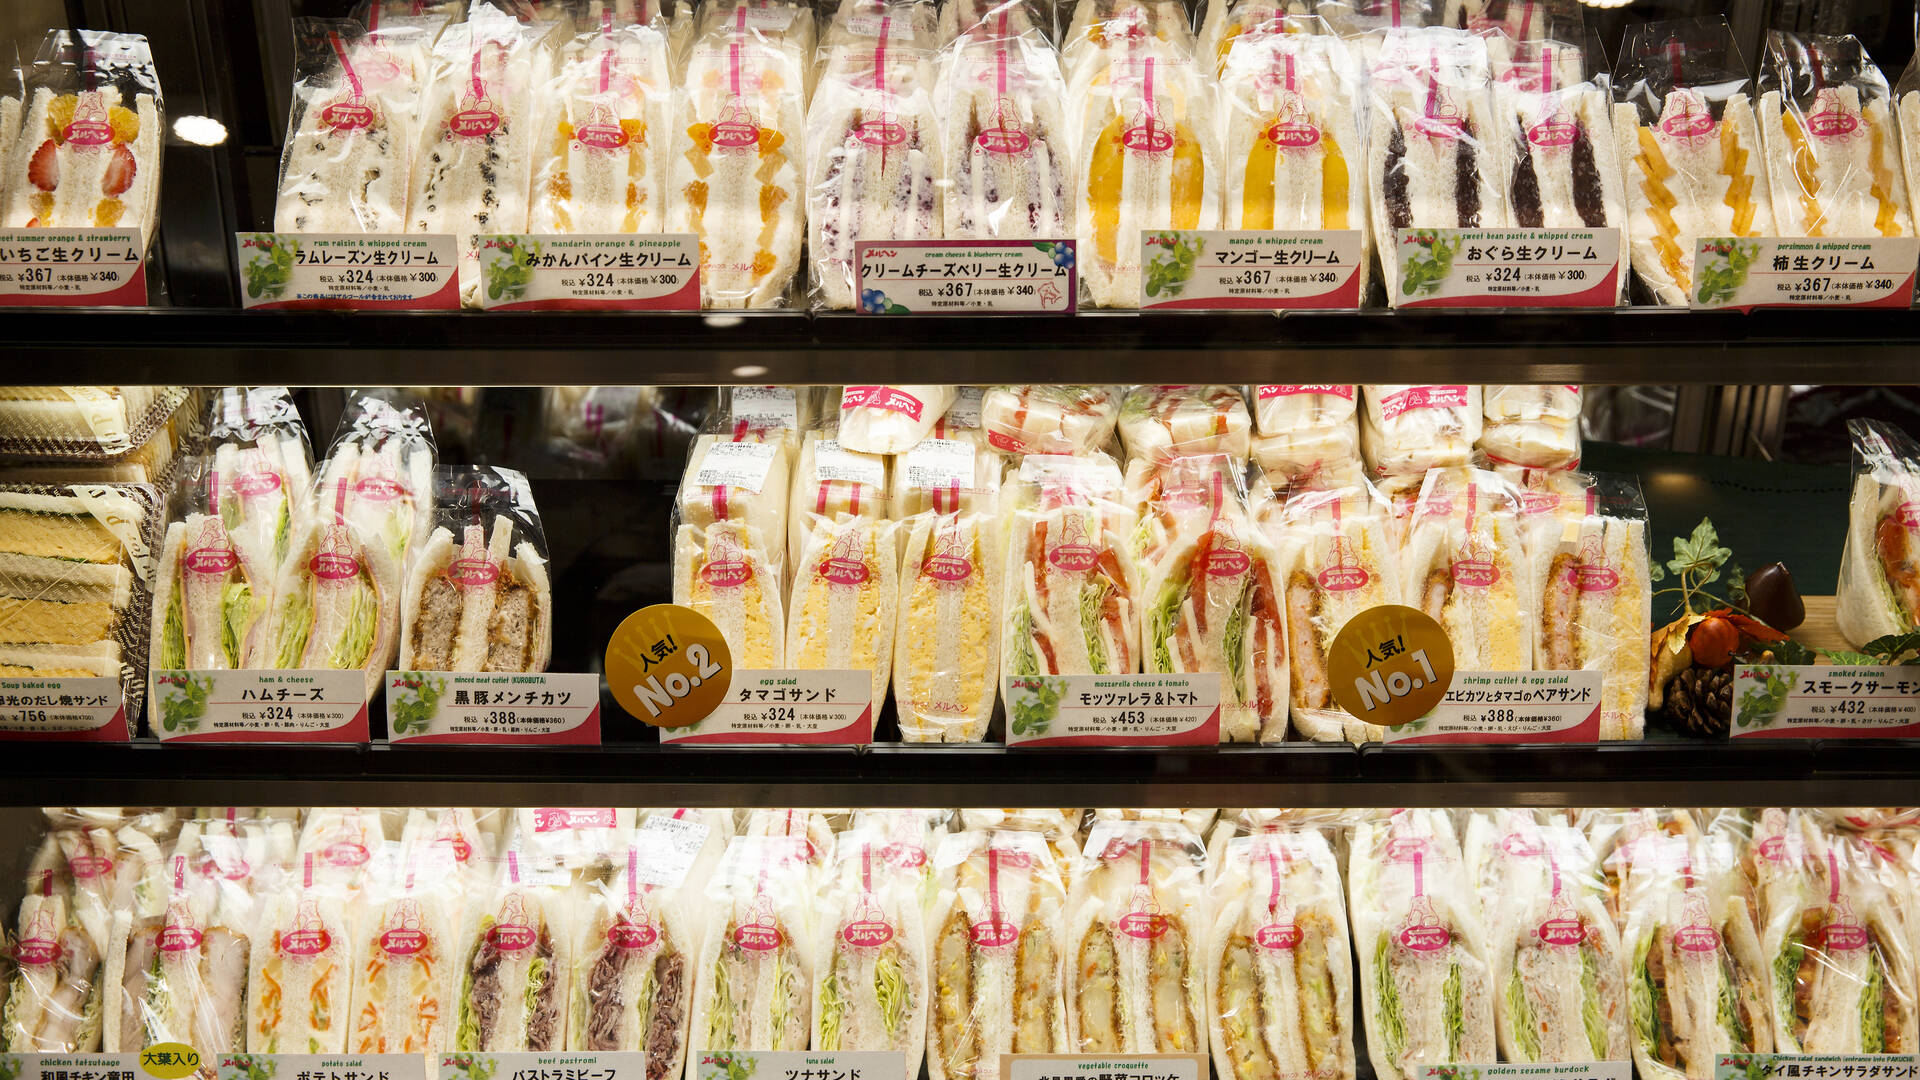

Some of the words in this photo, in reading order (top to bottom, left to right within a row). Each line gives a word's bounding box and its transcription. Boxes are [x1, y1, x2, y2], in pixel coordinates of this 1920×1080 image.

[86, 235, 131, 243] strawberry
[332, 239, 355, 247] raisin
[359, 239, 365, 247] &
[368, 239, 399, 248] whipped
[1266, 237, 1297, 246] whipped
[1462, 232, 1484, 240] sweet
[1486, 232, 1504, 240] bean
[1507, 232, 1527, 241] paste
[1530, 232, 1536, 240] &
[1539, 232, 1567, 241] whipped
[551, 239, 592, 248] mandarin
[595, 240, 625, 249] orange
[629, 239, 636, 247] &
[639, 239, 681, 249] pineapple
[1777, 243, 1814, 251] persimmon
[1823, 243, 1849, 251] whipped
[296, 249, 439, 265] ラムレーズン生クリーム
[864, 249, 897, 259] メルヘン
[946, 250, 966, 258] cheese
[974, 250, 1002, 259] blueberry
[1215, 250, 1341, 266] マンゴー生クリーム
[1467, 246, 1598, 262] おぐら生クリーム
[860, 263, 1067, 279] クリームチーズベリー生クリーム
[1773, 256, 1876, 272] 柿生クリーム
[18, 268, 52, 283] ¥367
[320, 275, 334, 283] 税込
[339, 270, 374, 284] ¥324
[561, 279, 576, 287] 税込
[579, 272, 614, 287] ¥324
[1219, 277, 1234, 285] 税込
[1236, 270, 1272, 285] ¥367
[1467, 274, 1481, 282] 税込
[1486, 267, 1522, 282] ¥324
[918, 289, 934, 297] 税込
[938, 282, 972, 297] ¥367
[1777, 284, 1791, 292] 税込
[1795, 278, 1831, 292] ¥367
[640, 634, 678, 672] 人気!
[1366, 635, 1406, 668] 人気!
[1354, 649, 1438, 711] No.1
[1463, 675, 1491, 685] shrimp
[1493, 674, 1518, 684] cutlet
[1522, 675, 1527, 684] &
[1530, 676, 1544, 686] egg
[1547, 674, 1569, 684] salad
[1829, 669, 1856, 677] smoked
[1860, 669, 1885, 677] salmon
[633, 643, 723, 718] No.2
[777, 677, 798, 686] salad
[1094, 679, 1130, 687] mozzarella
[1165, 679, 1190, 687] tomato
[242, 688, 325, 702] ハムチーズ
[1803, 681, 1920, 695] スモークサーモン
[454, 690, 571, 706] 黒豚メンチカツ
[739, 689, 837, 702] タマゴサンド
[1080, 691, 1199, 706] モッツァレラ&トマト
[242, 712, 256, 720] 税込
[259, 706, 293, 721] ¥324
[743, 712, 758, 721] 税込
[761, 707, 796, 721] ¥324
[1811, 706, 1826, 714] 税込
[1830, 700, 1866, 715] ¥432
[12, 710, 47, 722] ¥756
[463, 716, 478, 724] 税込
[483, 711, 516, 725] ¥388
[1092, 716, 1107, 724] 税込
[1111, 711, 1145, 725] ¥453
[1463, 714, 1477, 723] 税込
[1480, 709, 1514, 723] ¥388
[40, 1058, 72, 1066] chicken
[142, 1051, 199, 1067] 大葉入り
[322, 1060, 344, 1068] potato
[539, 1056, 556, 1064] beef
[820, 1057, 835, 1065] salad
[1077, 1061, 1111, 1070] vegetable
[785, 1069, 861, 1080] ツナサンド
[1487, 1066, 1517, 1075] golden
[1520, 1067, 1551, 1075] sesame
[1554, 1065, 1591, 1074] burdock
[1761, 1065, 1919, 1078] タイ風チキンサラダサンド
